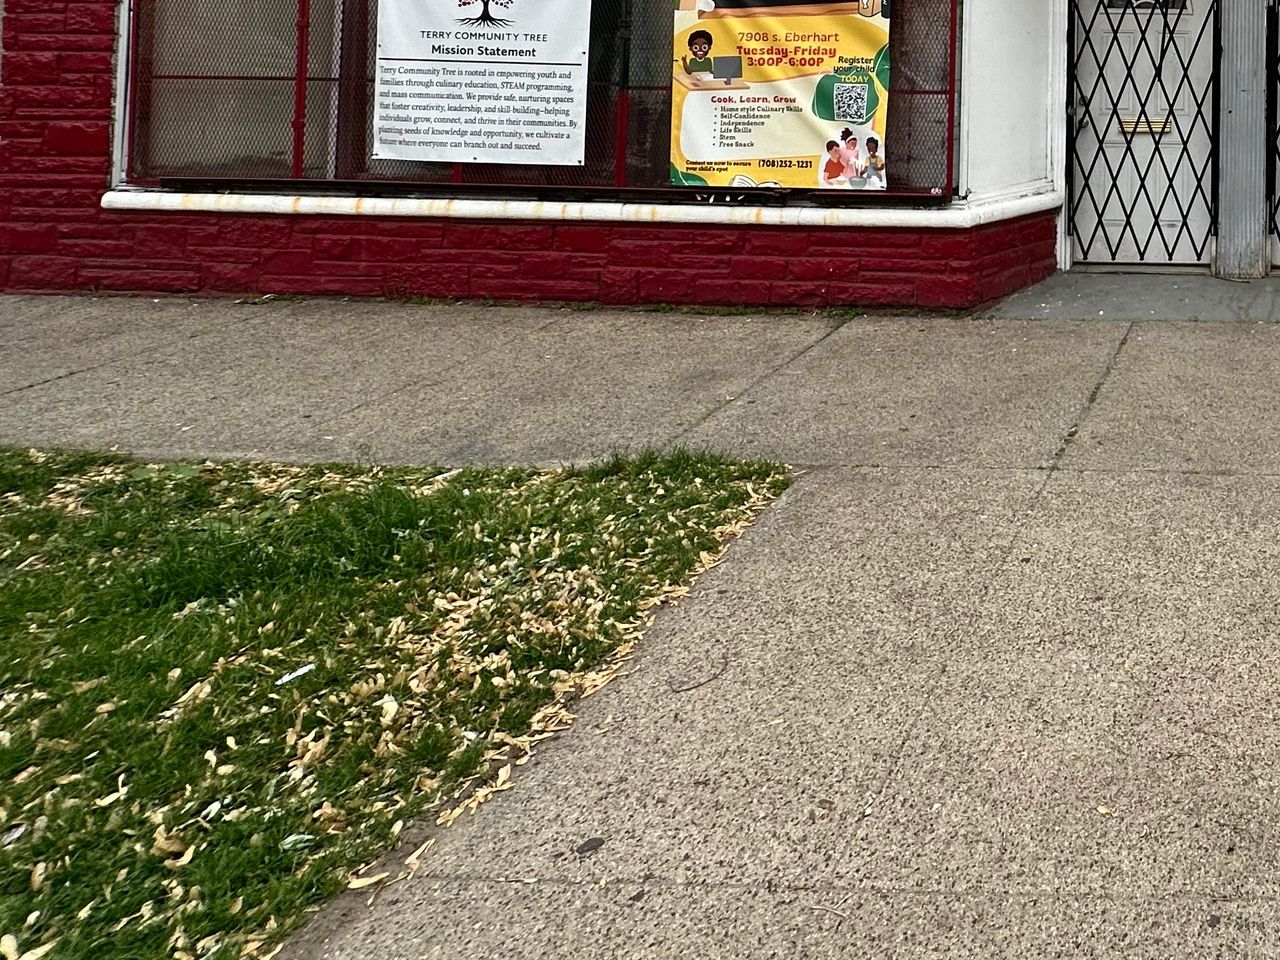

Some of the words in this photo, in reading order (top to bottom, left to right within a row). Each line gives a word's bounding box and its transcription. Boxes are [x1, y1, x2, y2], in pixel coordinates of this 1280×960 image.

[420, 31, 451, 39] TERRY
[455, 32, 519, 40] COMMUNITY
[738, 33, 768, 41] 7908
[785, 33, 840, 41] Eberhart
[431, 45, 473, 55] Mission
[477, 46, 536, 57] Statement
[736, 46, 836, 58] Tuesday-Friday
[747, 57, 824, 66] 3:00P-6:00P
[838, 56, 874, 65] Register
[380, 66, 396, 75] Terry
[398, 67, 440, 76] Community
[537, 71, 557, 79] youth
[841, 75, 868, 83] TODAY
[406, 79, 434, 88] through
[436, 81, 463, 89] culinary
[464, 80, 499, 89] education,
[526, 84, 573, 92] programming,
[478, 93, 502, 102] provide
[504, 94, 517, 102] safe,
[519, 95, 551, 104] nurturing
[392, 102, 410, 110] foster
[412, 103, 446, 112] creativity,
[447, 104, 483, 113] leadership,
[478, 117, 497, 125] thrive
[498, 117, 504, 125] in
[523, 119, 567, 127] communities.
[569, 120, 577, 128] By
[720, 120, 765, 128] Independence
[431, 127, 468, 137] knowledge
[470, 128, 481, 136] and
[483, 130, 524, 139] opportunity,
[536, 130, 565, 138] cultivate
[399, 138, 417, 146] where
[464, 140, 486, 148] branch
[758, 160, 813, 168] (708)252-1231
